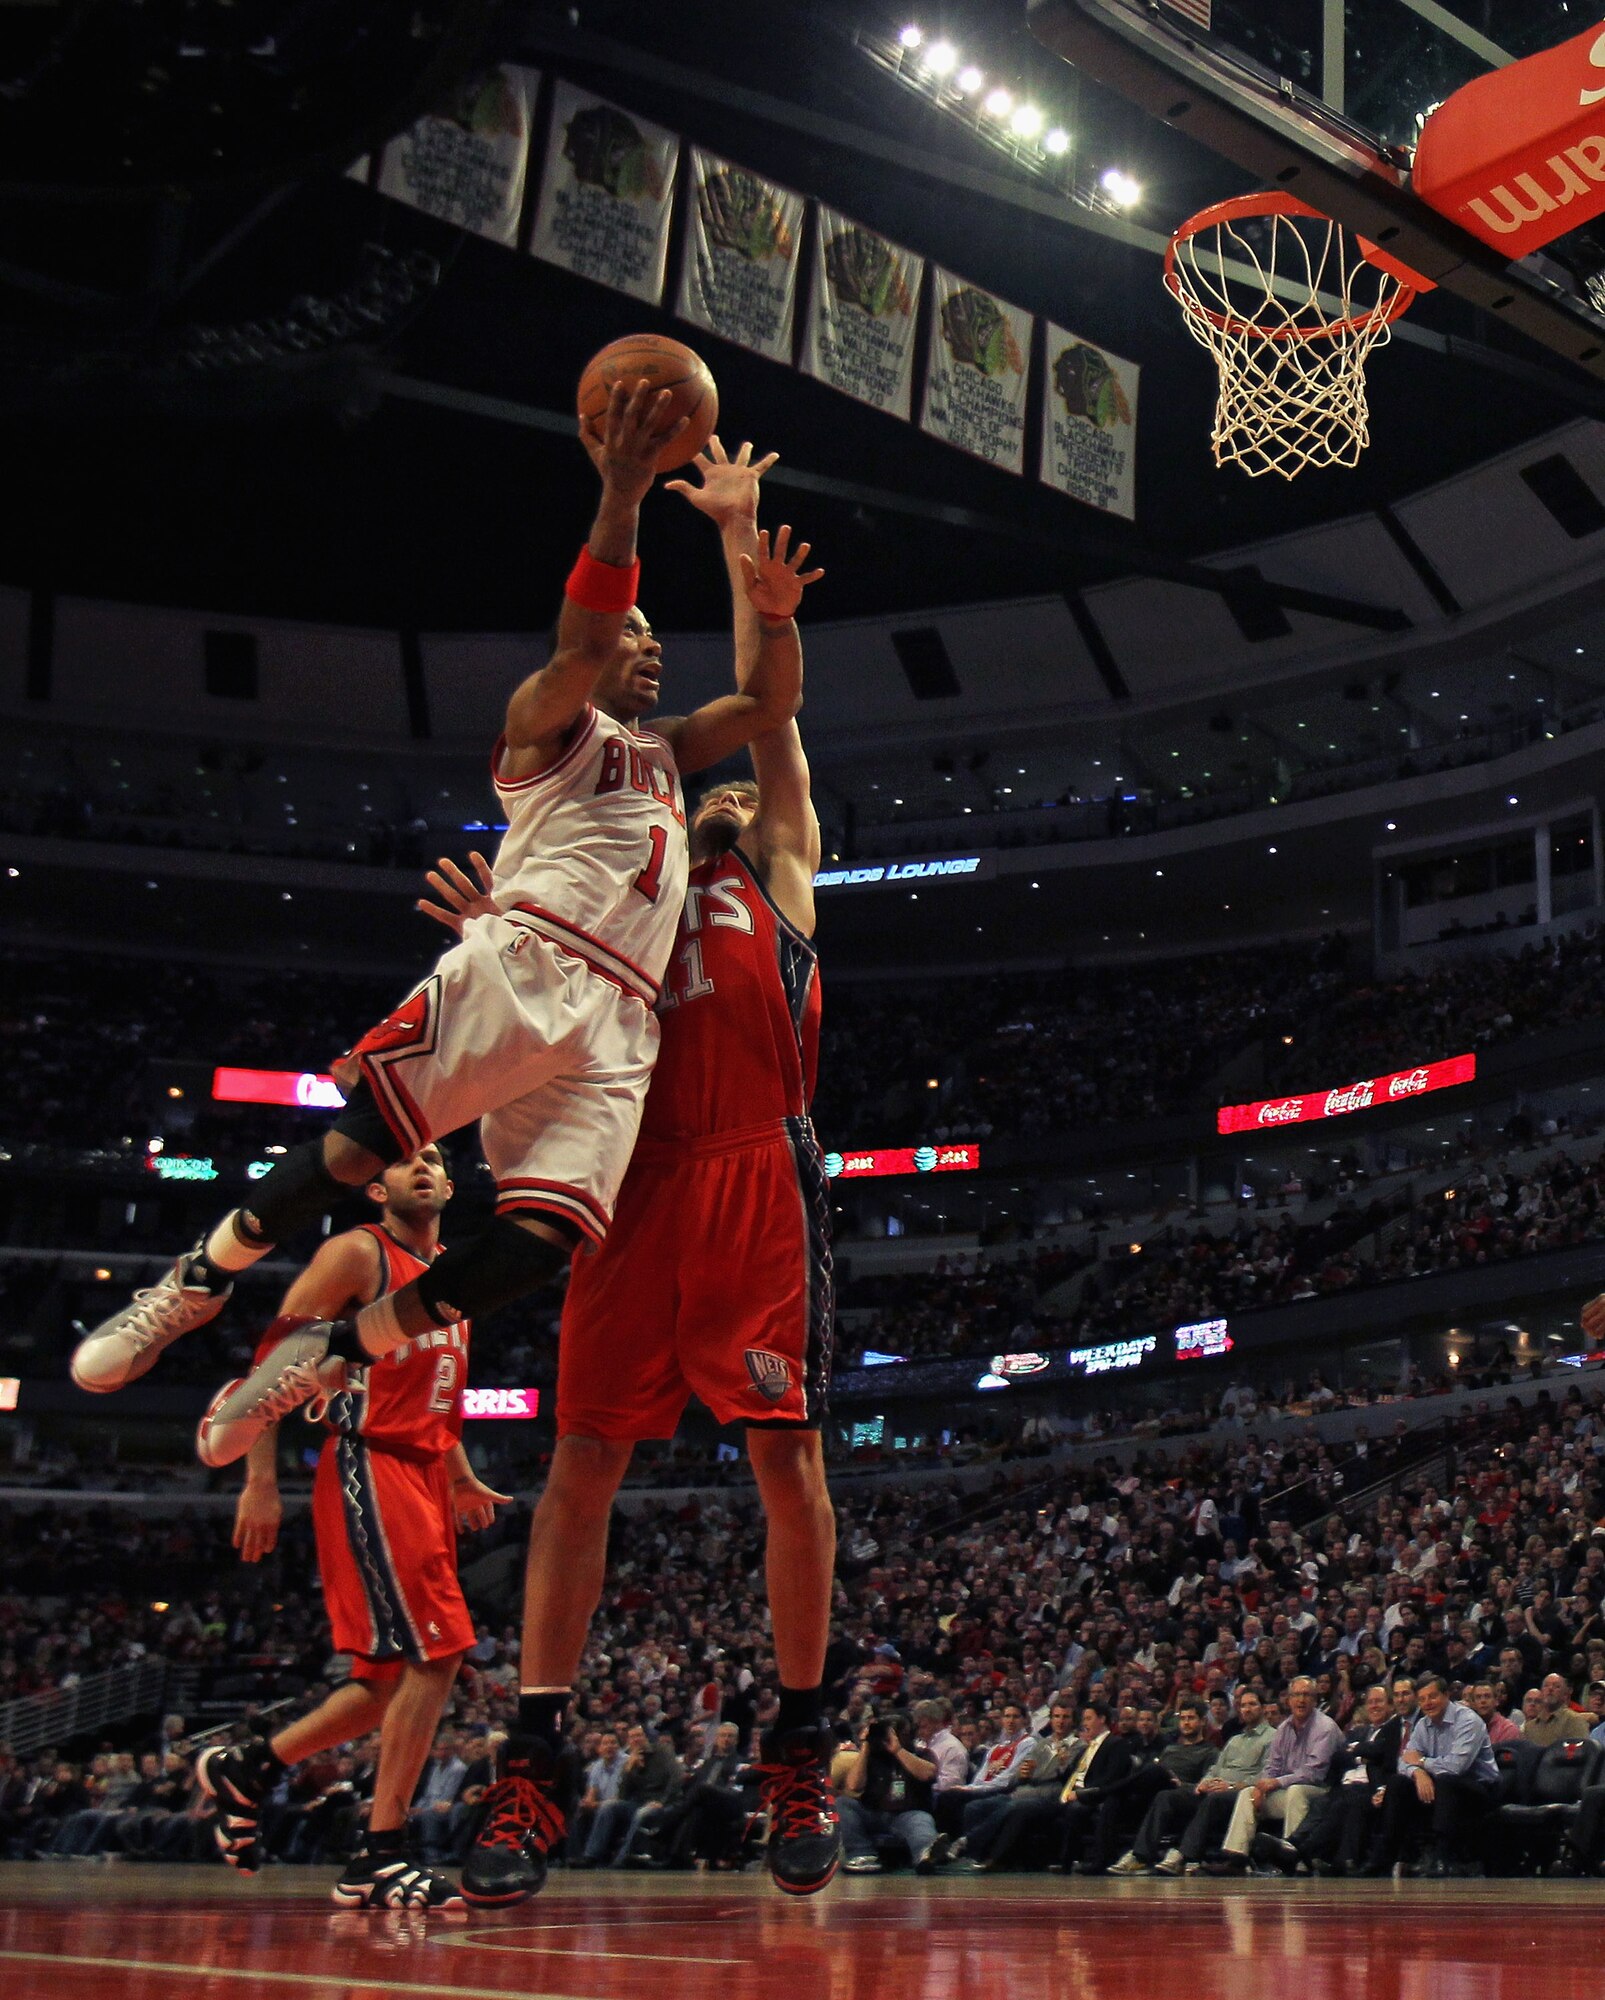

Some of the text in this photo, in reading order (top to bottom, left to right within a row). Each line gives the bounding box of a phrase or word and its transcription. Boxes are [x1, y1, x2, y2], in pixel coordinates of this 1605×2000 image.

[819, 305, 904, 358] BACKHAWKS
[838, 301, 889, 338] CHICAGO
[953, 361, 1003, 396] CHICAGO
[1053, 421, 1126, 463] BLACKHAWKS
[1066, 415, 1114, 447] CHICAGO
[1057, 461, 1119, 500] CHAMPIONS
[1067, 450, 1110, 482] TROPHY
[595, 736, 687, 829] BULL
[632, 824, 669, 905] 1
[886, 857, 981, 880] LOUNGE
[1069, 1336, 1157, 1365] WEEKDAYS
[428, 1353, 457, 1412] 2
